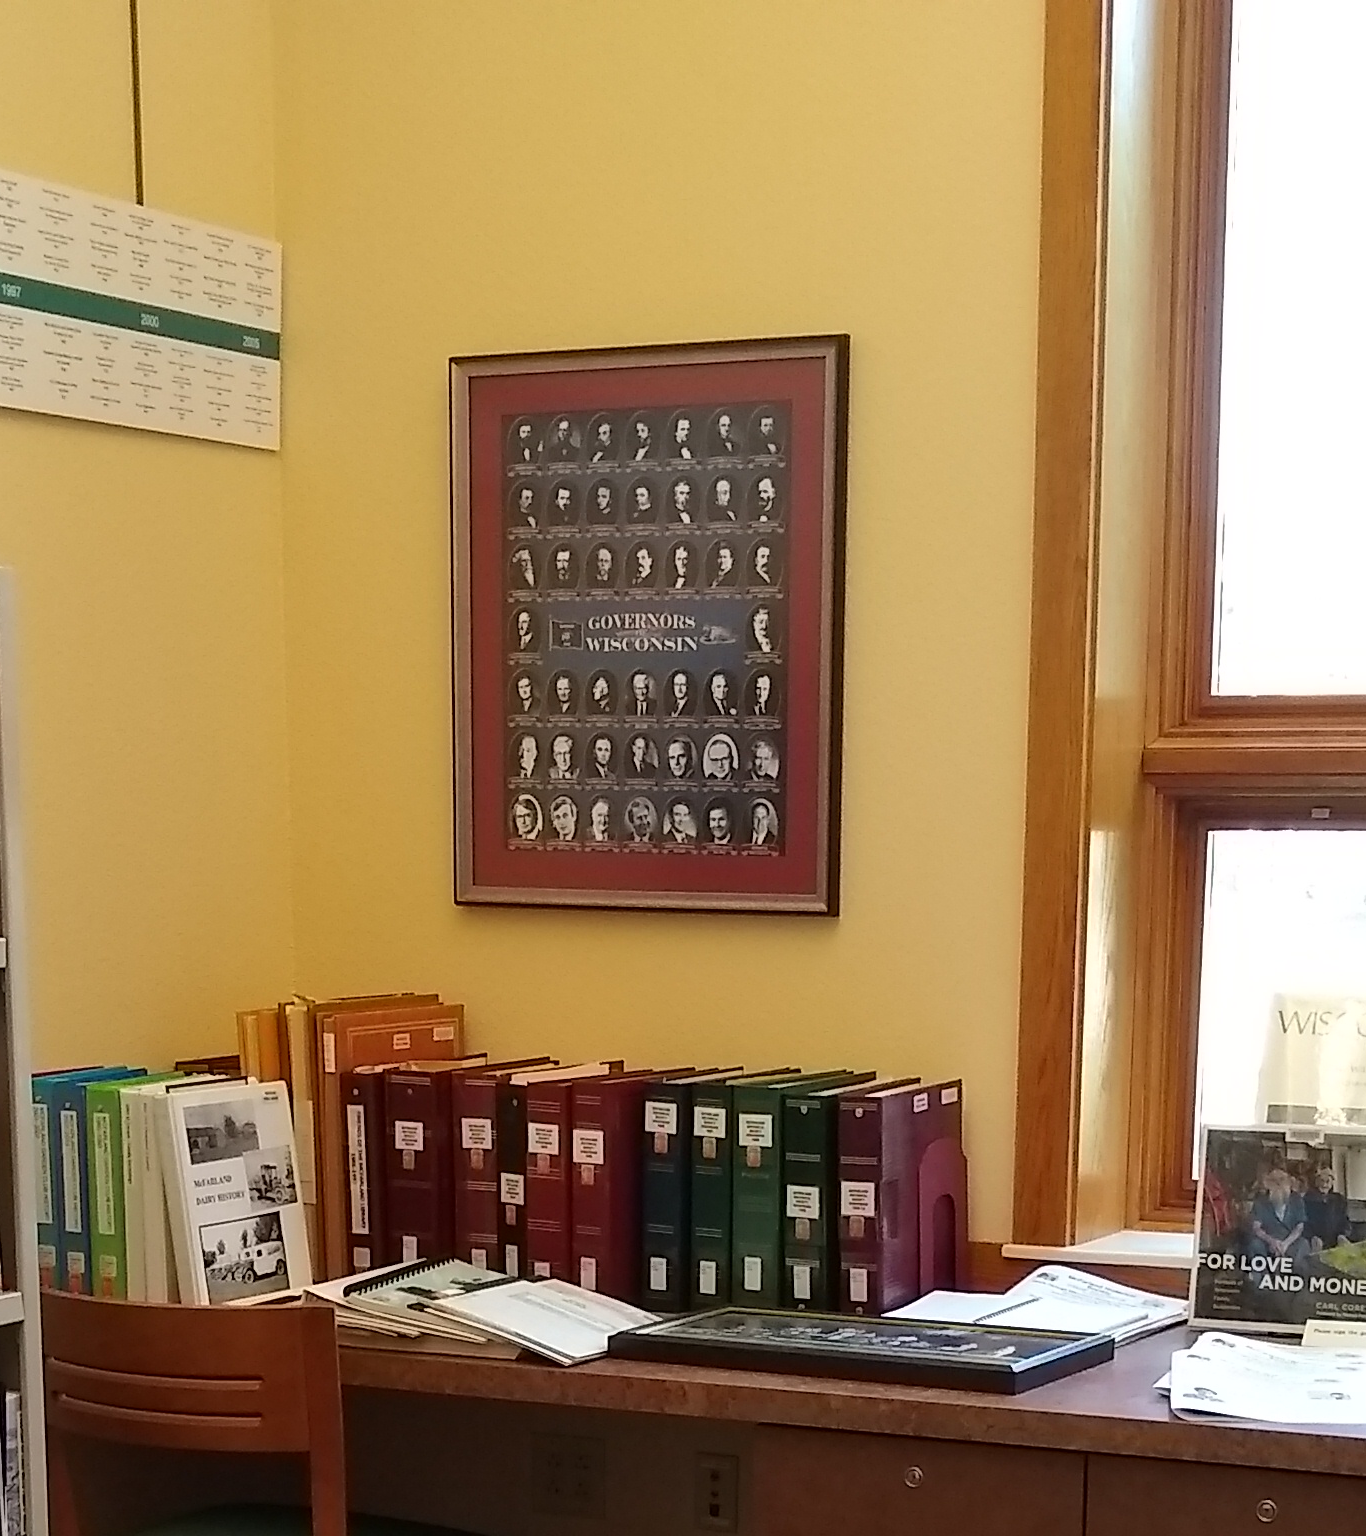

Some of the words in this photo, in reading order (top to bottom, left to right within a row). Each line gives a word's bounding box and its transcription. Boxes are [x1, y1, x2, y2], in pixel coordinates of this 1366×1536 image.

[140, 314, 159, 328] 2000
[587, 613, 697, 632] GOVERNORS
[586, 635, 699, 653] WISCONSIN
[193, 1174, 233, 1190] McFARLAND
[195, 1193, 216, 1206] DAIRY
[217, 1190, 247, 1204] HISTORY
[1197, 1253, 1236, 1271] FOR
[1240, 1254, 1294, 1274] LOVE
[1258, 1275, 1305, 1293] AND
[1315, 1301, 1340, 1312] CARL
[1313, 1327, 1331, 1335] Please
